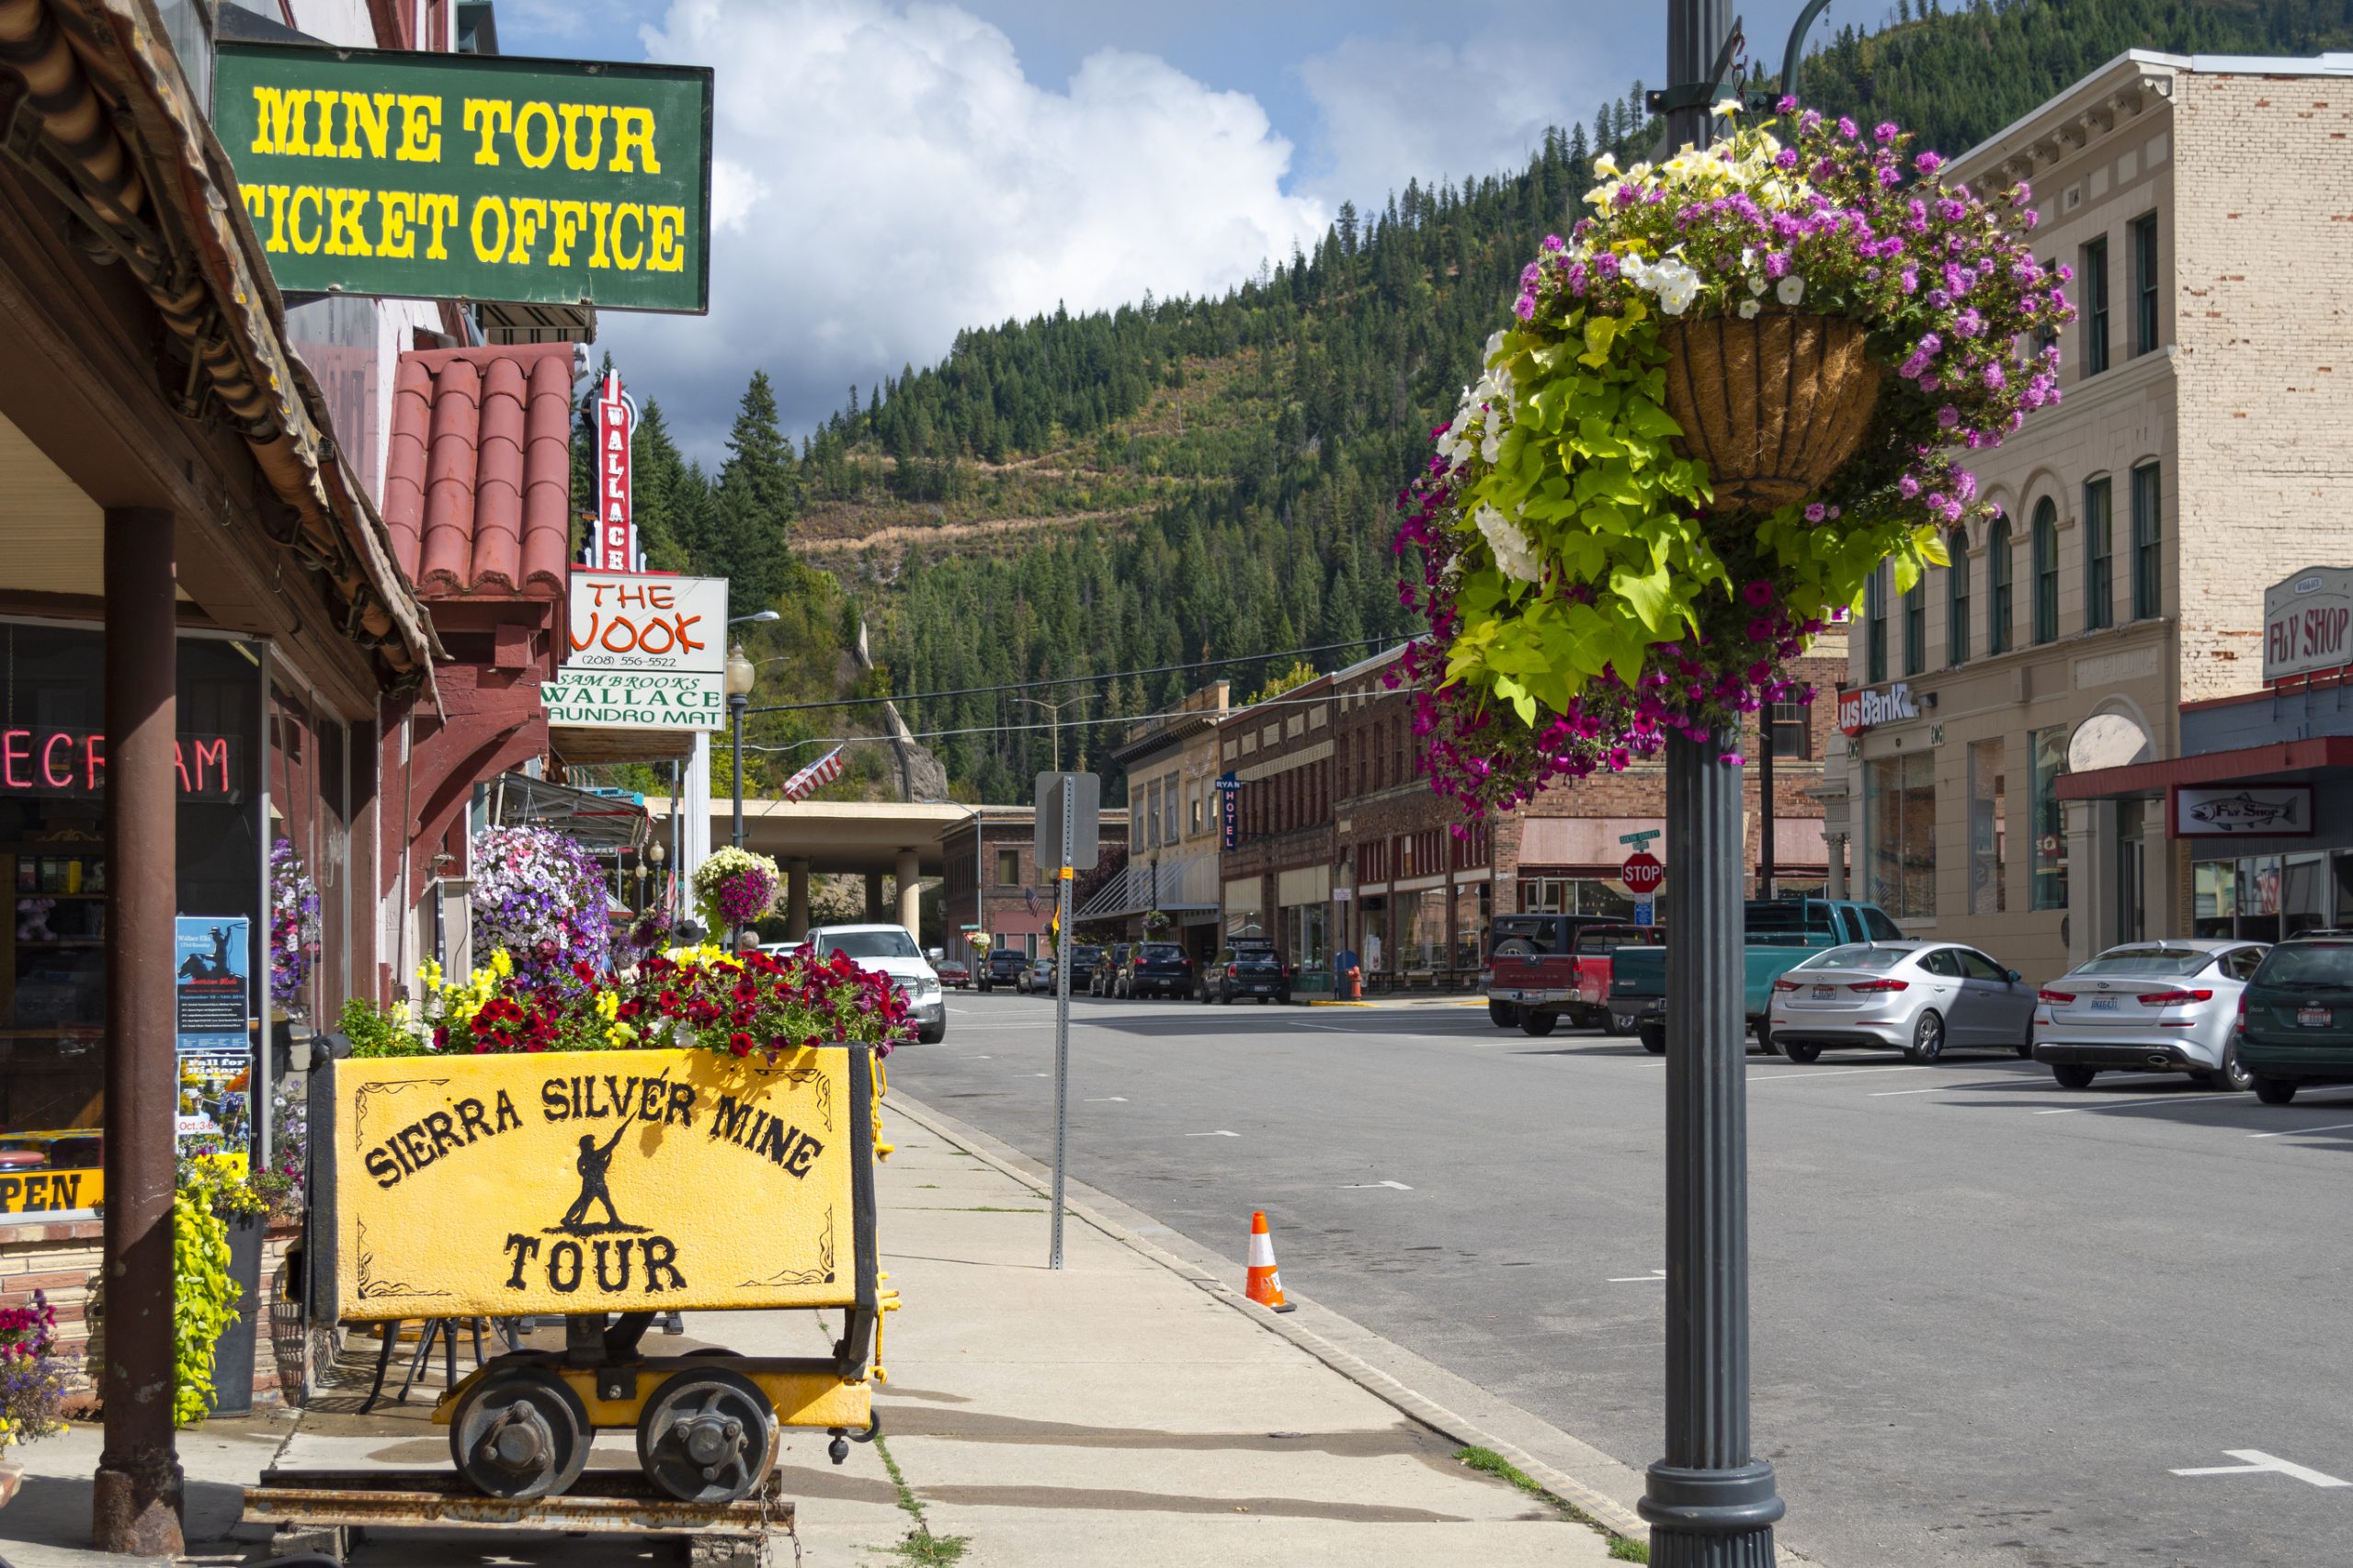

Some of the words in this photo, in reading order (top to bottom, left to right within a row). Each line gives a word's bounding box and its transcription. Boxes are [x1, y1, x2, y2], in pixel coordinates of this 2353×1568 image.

[251, 86, 442, 163] MINE
[463, 97, 661, 175] TOUR
[470, 195, 686, 273] OFFICE
[607, 406, 625, 571] WALLACE
[586, 583, 676, 609] THE
[2268, 613, 2299, 665] FLY
[2303, 608, 2349, 658] SHOP
[582, 655, 615, 666] (208)
[620, 656, 676, 667] 556-5522
[555, 674, 607, 687] SAM
[608, 676, 700, 690] BROOKS
[540, 687, 722, 708] WALLACE
[548, 707, 655, 723] AUNDRO
[662, 710, 722, 725] MAT
[1226, 791, 1234, 846] HOTEL
[1624, 866, 1660, 881] STOP
[187, 1058, 219, 1066] Fall
[221, 1058, 245, 1066] for
[180, 1120, 199, 1131] Oct.
[364, 1088, 522, 1190] SIERRA
[541, 1074, 698, 1127] SILVER
[710, 1095, 825, 1181] MINE
[504, 1233, 688, 1294] TOUR
